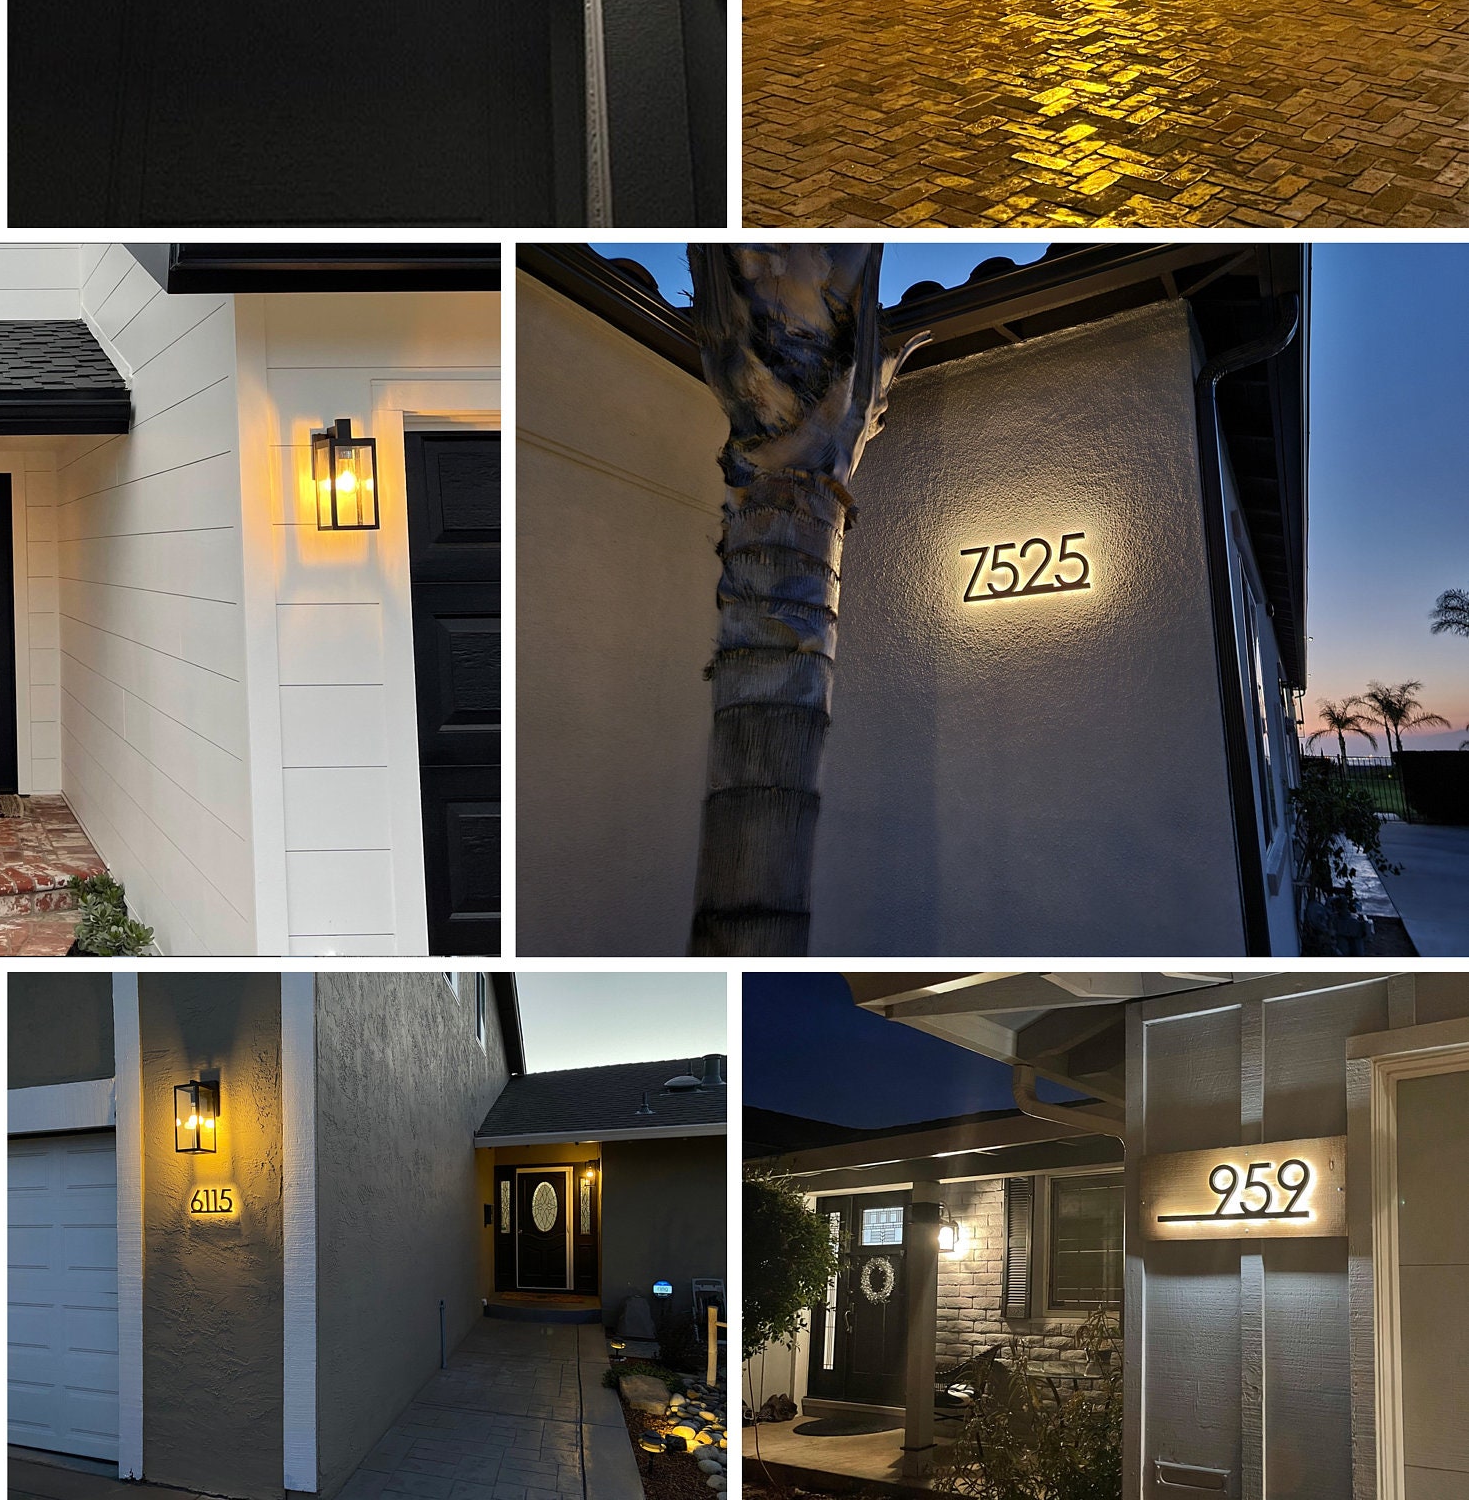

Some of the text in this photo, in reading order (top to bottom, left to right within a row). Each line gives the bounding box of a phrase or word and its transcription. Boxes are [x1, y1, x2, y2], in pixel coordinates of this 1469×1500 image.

[961, 532, 1090, 601] 7525
[191, 1188, 233, 1213] 6115
[1209, 1159, 1310, 1216] 959
